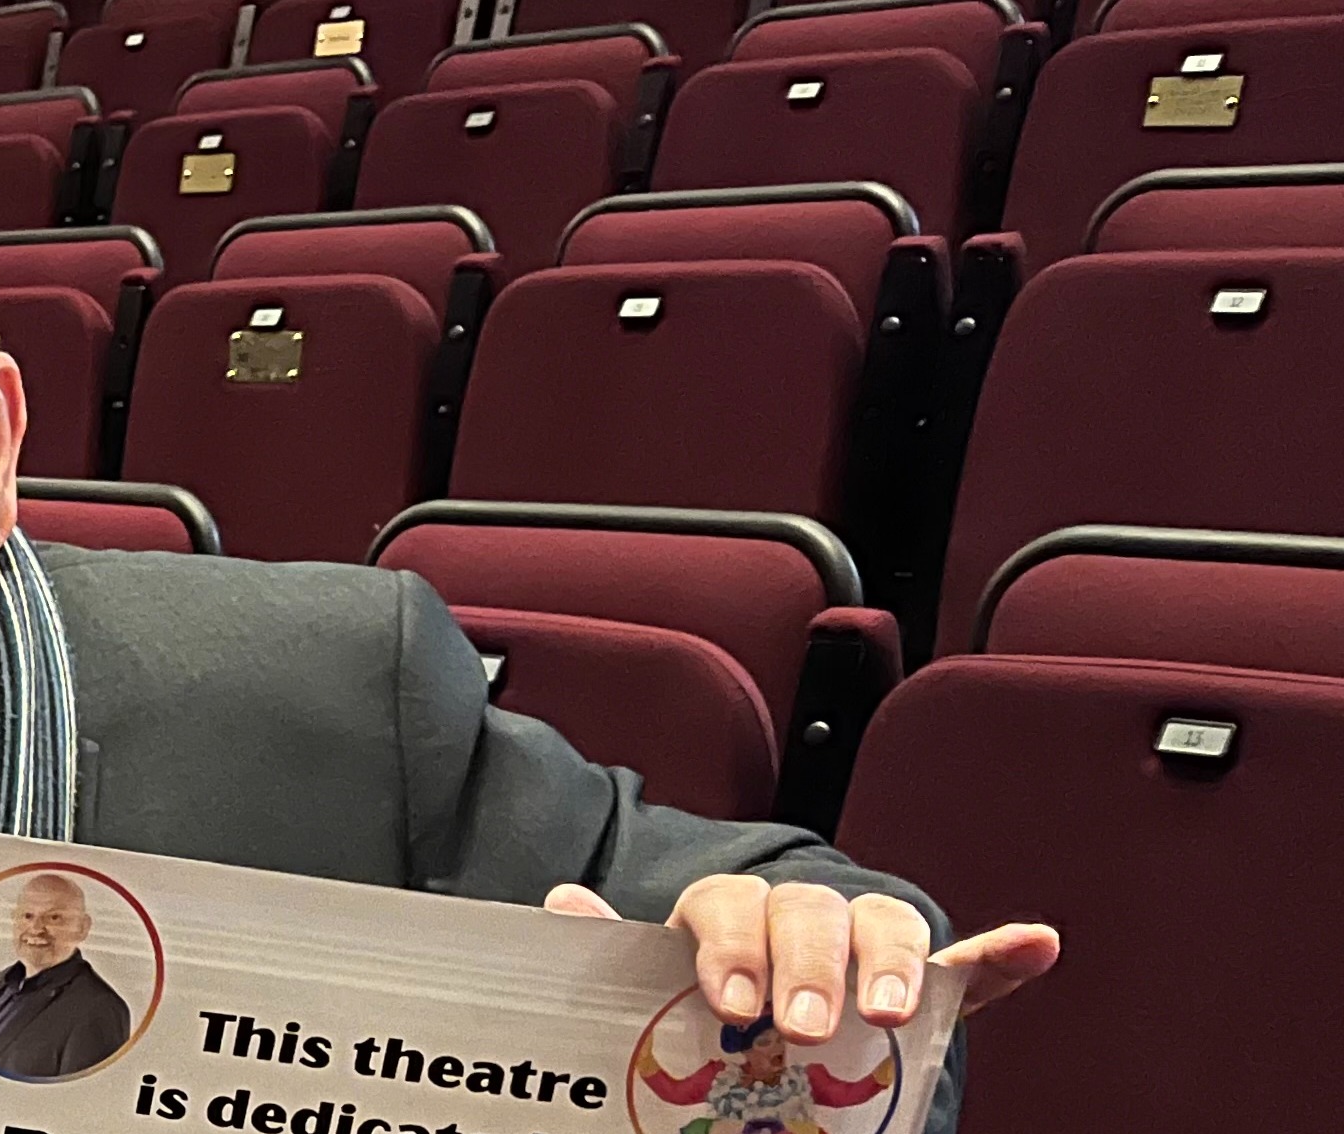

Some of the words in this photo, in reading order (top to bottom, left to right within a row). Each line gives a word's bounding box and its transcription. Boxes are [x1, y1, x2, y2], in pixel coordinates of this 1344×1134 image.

[198, 1011, 333, 1069] This
[353, 1037, 608, 1110] theatre
[135, 1074, 189, 1120] is
